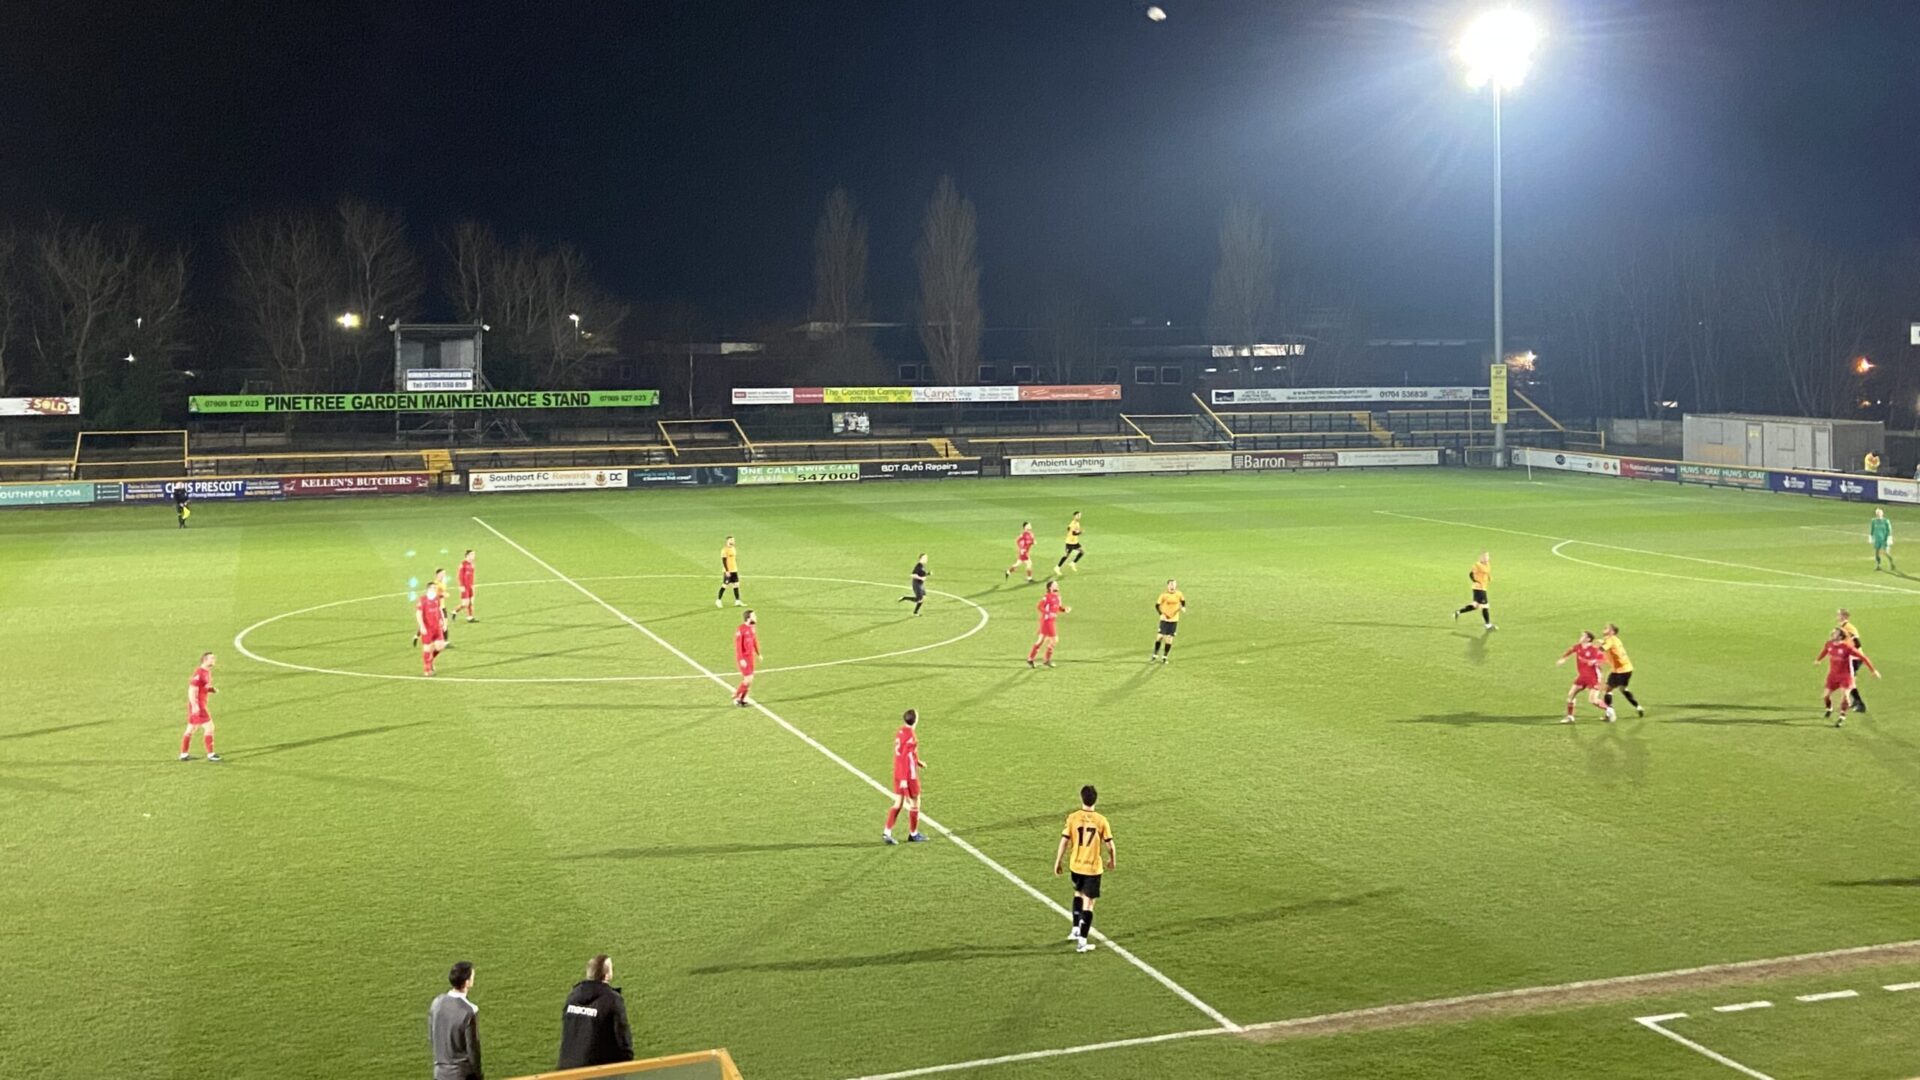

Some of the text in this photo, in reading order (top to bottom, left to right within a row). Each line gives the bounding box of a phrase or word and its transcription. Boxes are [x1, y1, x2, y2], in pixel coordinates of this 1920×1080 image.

[877, 388, 912, 398] Company
[923, 388, 956, 400] Carpet
[1380, 390, 1399, 398] 01704
[33, 398, 67, 412] SOLD
[264, 392, 590, 411] PINETREE GARDEN MAINTENANCE STAND
[797, 462, 858, 473] KWIK CARS
[1031, 458, 1104, 470] Ambient Lighting
[1244, 455, 1286, 468] Barron
[741, 466, 794, 475] ONE CALL
[902, 462, 924, 472] Auto
[925, 463, 958, 474] Repairs
[1680, 466, 1721, 476] HUWS GRAY
[489, 471, 592, 482] Southport FC Rewards
[610, 472, 622, 482] DC
[798, 470, 858, 482] 547000
[1722, 470, 1744, 478] HUWS
[1746, 471, 1766, 480] GRAY
[165, 482, 194, 494] CHIS
[195, 480, 244, 492] PRESCOTT
[301, 476, 412, 488] KELLEN'S BUTCHERS
[1077, 826, 1096, 848] 17
[566, 1004, 598, 1018] macron
